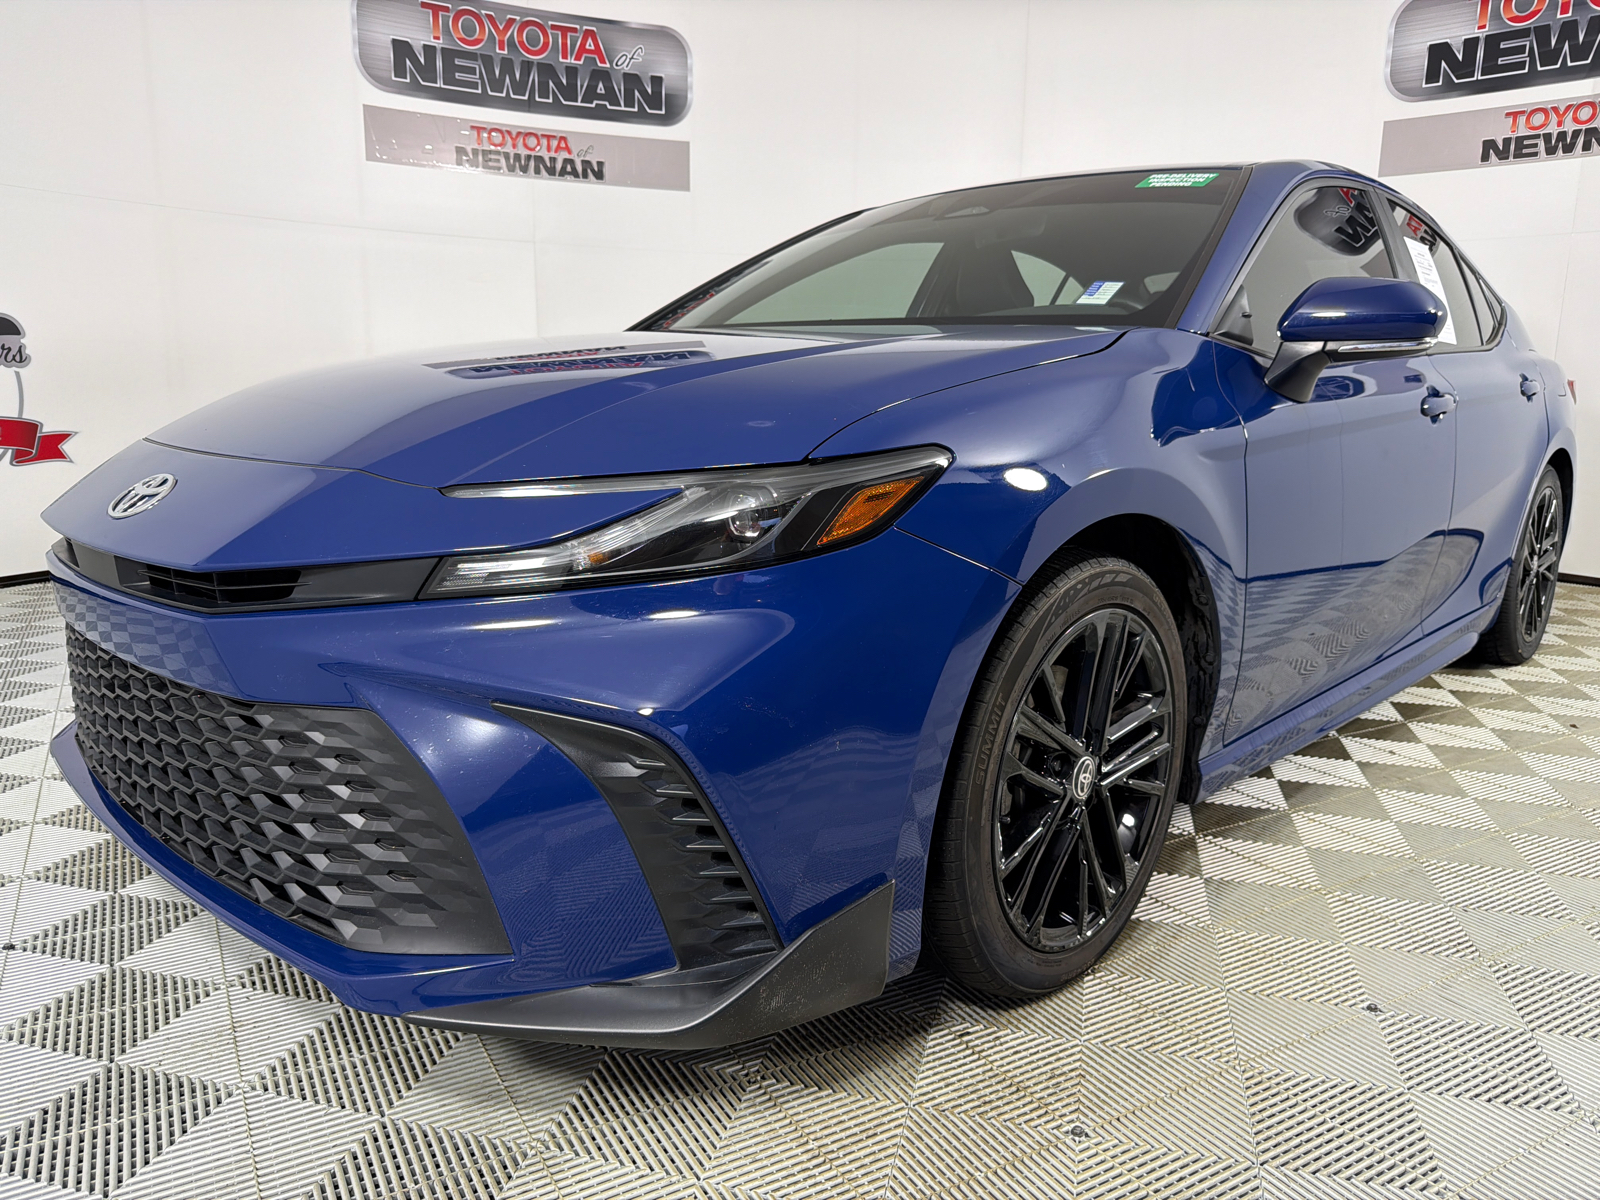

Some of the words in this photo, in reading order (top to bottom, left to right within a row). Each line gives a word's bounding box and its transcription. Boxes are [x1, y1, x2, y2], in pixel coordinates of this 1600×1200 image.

[420, 1, 610, 66] TOYOTA
[613, 46, 645, 70] of
[391, 38, 667, 115] NEWNAN
[470, 125, 573, 156] TOYOTA
[1505, 100, 1600, 134] TOYO
[454, 146, 605, 182] NEWNAN
[975, 692, 1006, 785] SUMMIT
